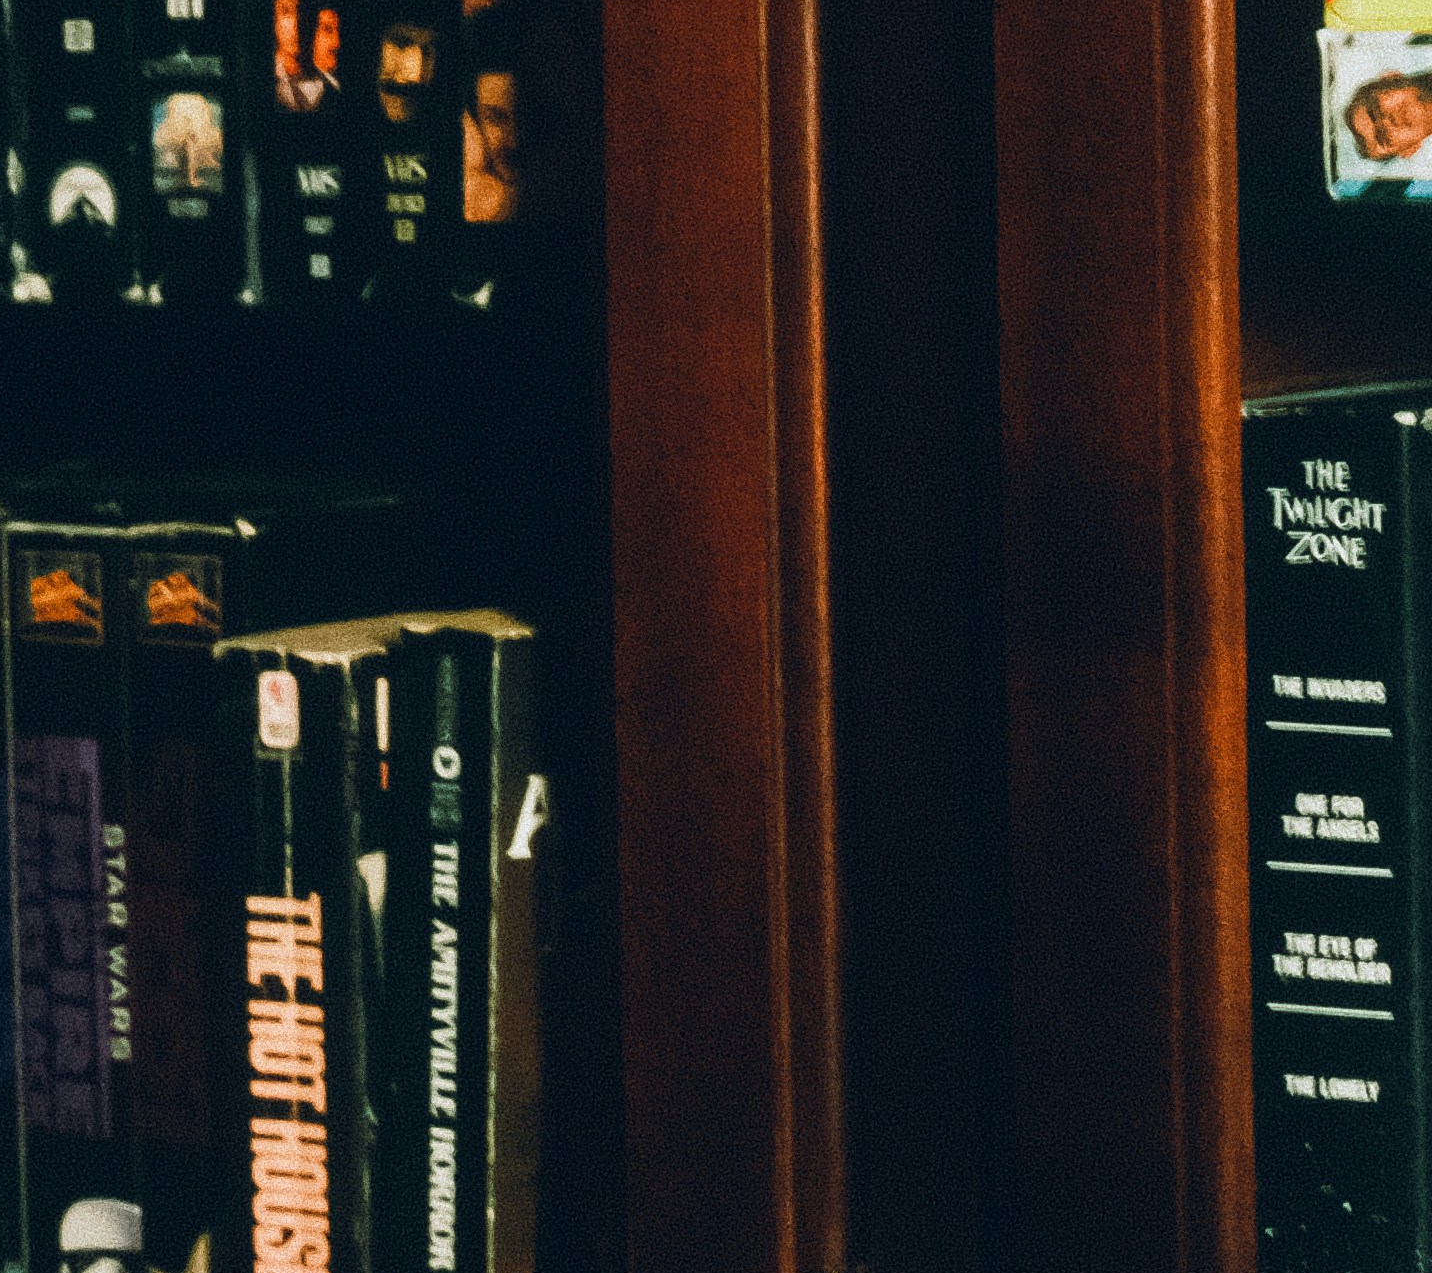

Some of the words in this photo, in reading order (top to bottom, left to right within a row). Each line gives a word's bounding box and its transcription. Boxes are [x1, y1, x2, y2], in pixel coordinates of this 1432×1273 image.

[1301, 457, 1351, 492] THE
[1265, 486, 1388, 534] TWILIGHT
[1284, 530, 1368, 570] ZONE
[1272, 674, 1304, 699] THE
[1295, 792, 1329, 816] ONE
[1330, 795, 1364, 819] FOR
[1281, 814, 1314, 839] THE
[1315, 817, 1380, 844] ANGELS
[102, 823, 128, 927] STAR
[430, 839, 459, 910] THE
[246, 891, 324, 995] THE
[1284, 932, 1316, 957] THE
[1272, 954, 1305, 979] THE
[108, 943, 133, 1064] WARS
[429, 917, 459, 1119] AMITYVILLE
[248, 997, 326, 1115] HOT
[1283, 1073, 1317, 1099] THE
[428, 1125, 458, 1272] HORROR
